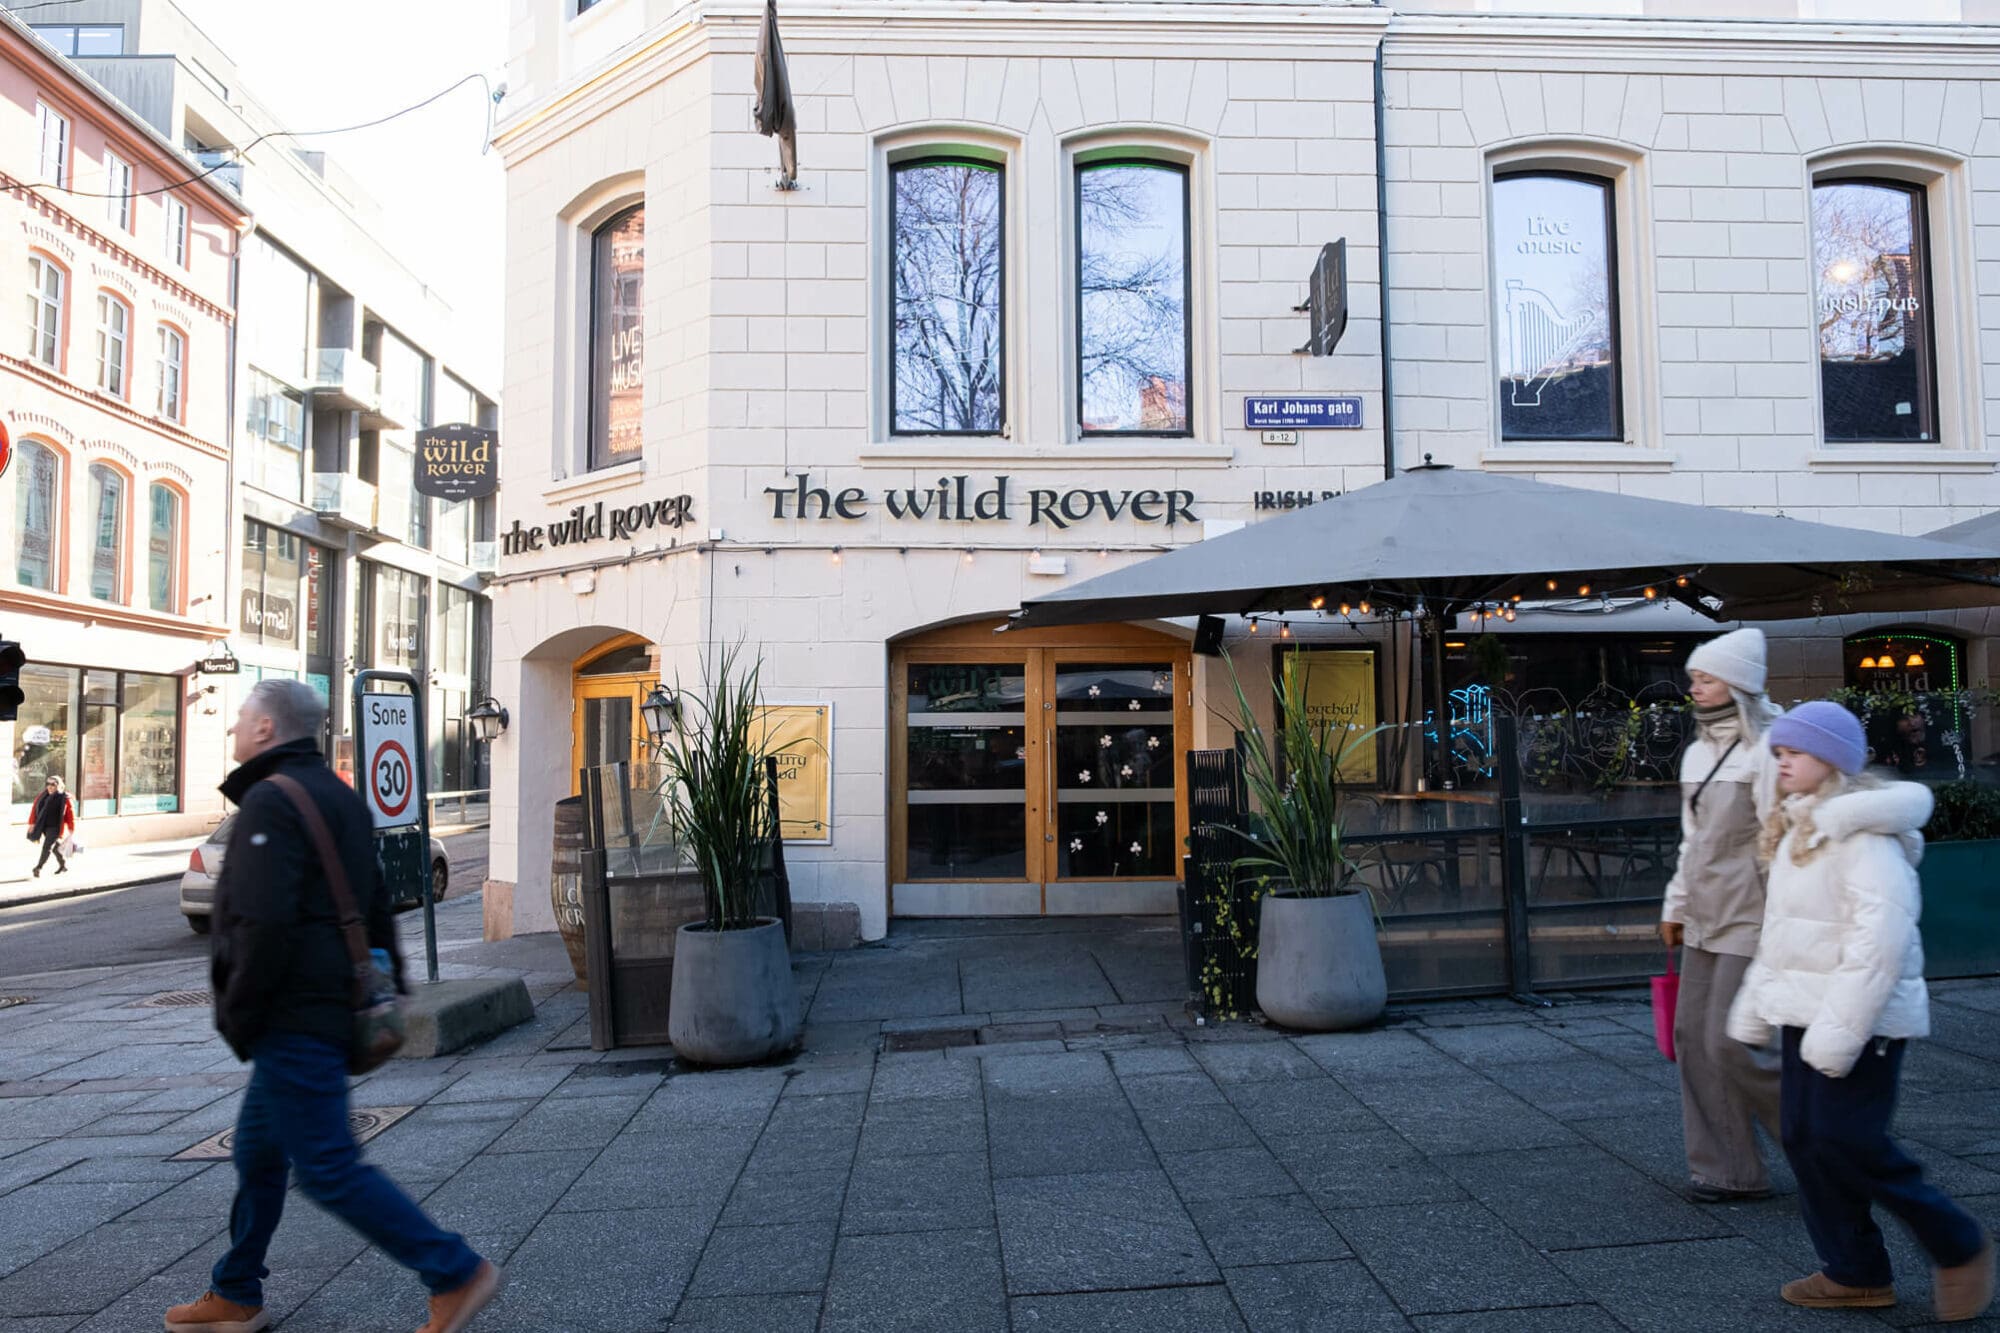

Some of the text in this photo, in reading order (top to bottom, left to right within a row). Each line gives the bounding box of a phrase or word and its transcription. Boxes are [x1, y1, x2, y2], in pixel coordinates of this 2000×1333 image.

[611, 326, 641, 359] LIVE
[611, 359, 644, 393] MUSI
[1254, 402, 1353, 416] Karl Johans gate
[1254, 491, 1313, 509] IRISH
[246, 598, 290, 630] Normal
[204, 661, 235, 671] Normal
[372, 702, 407, 726] Sone
[379, 759, 406, 797] 30
